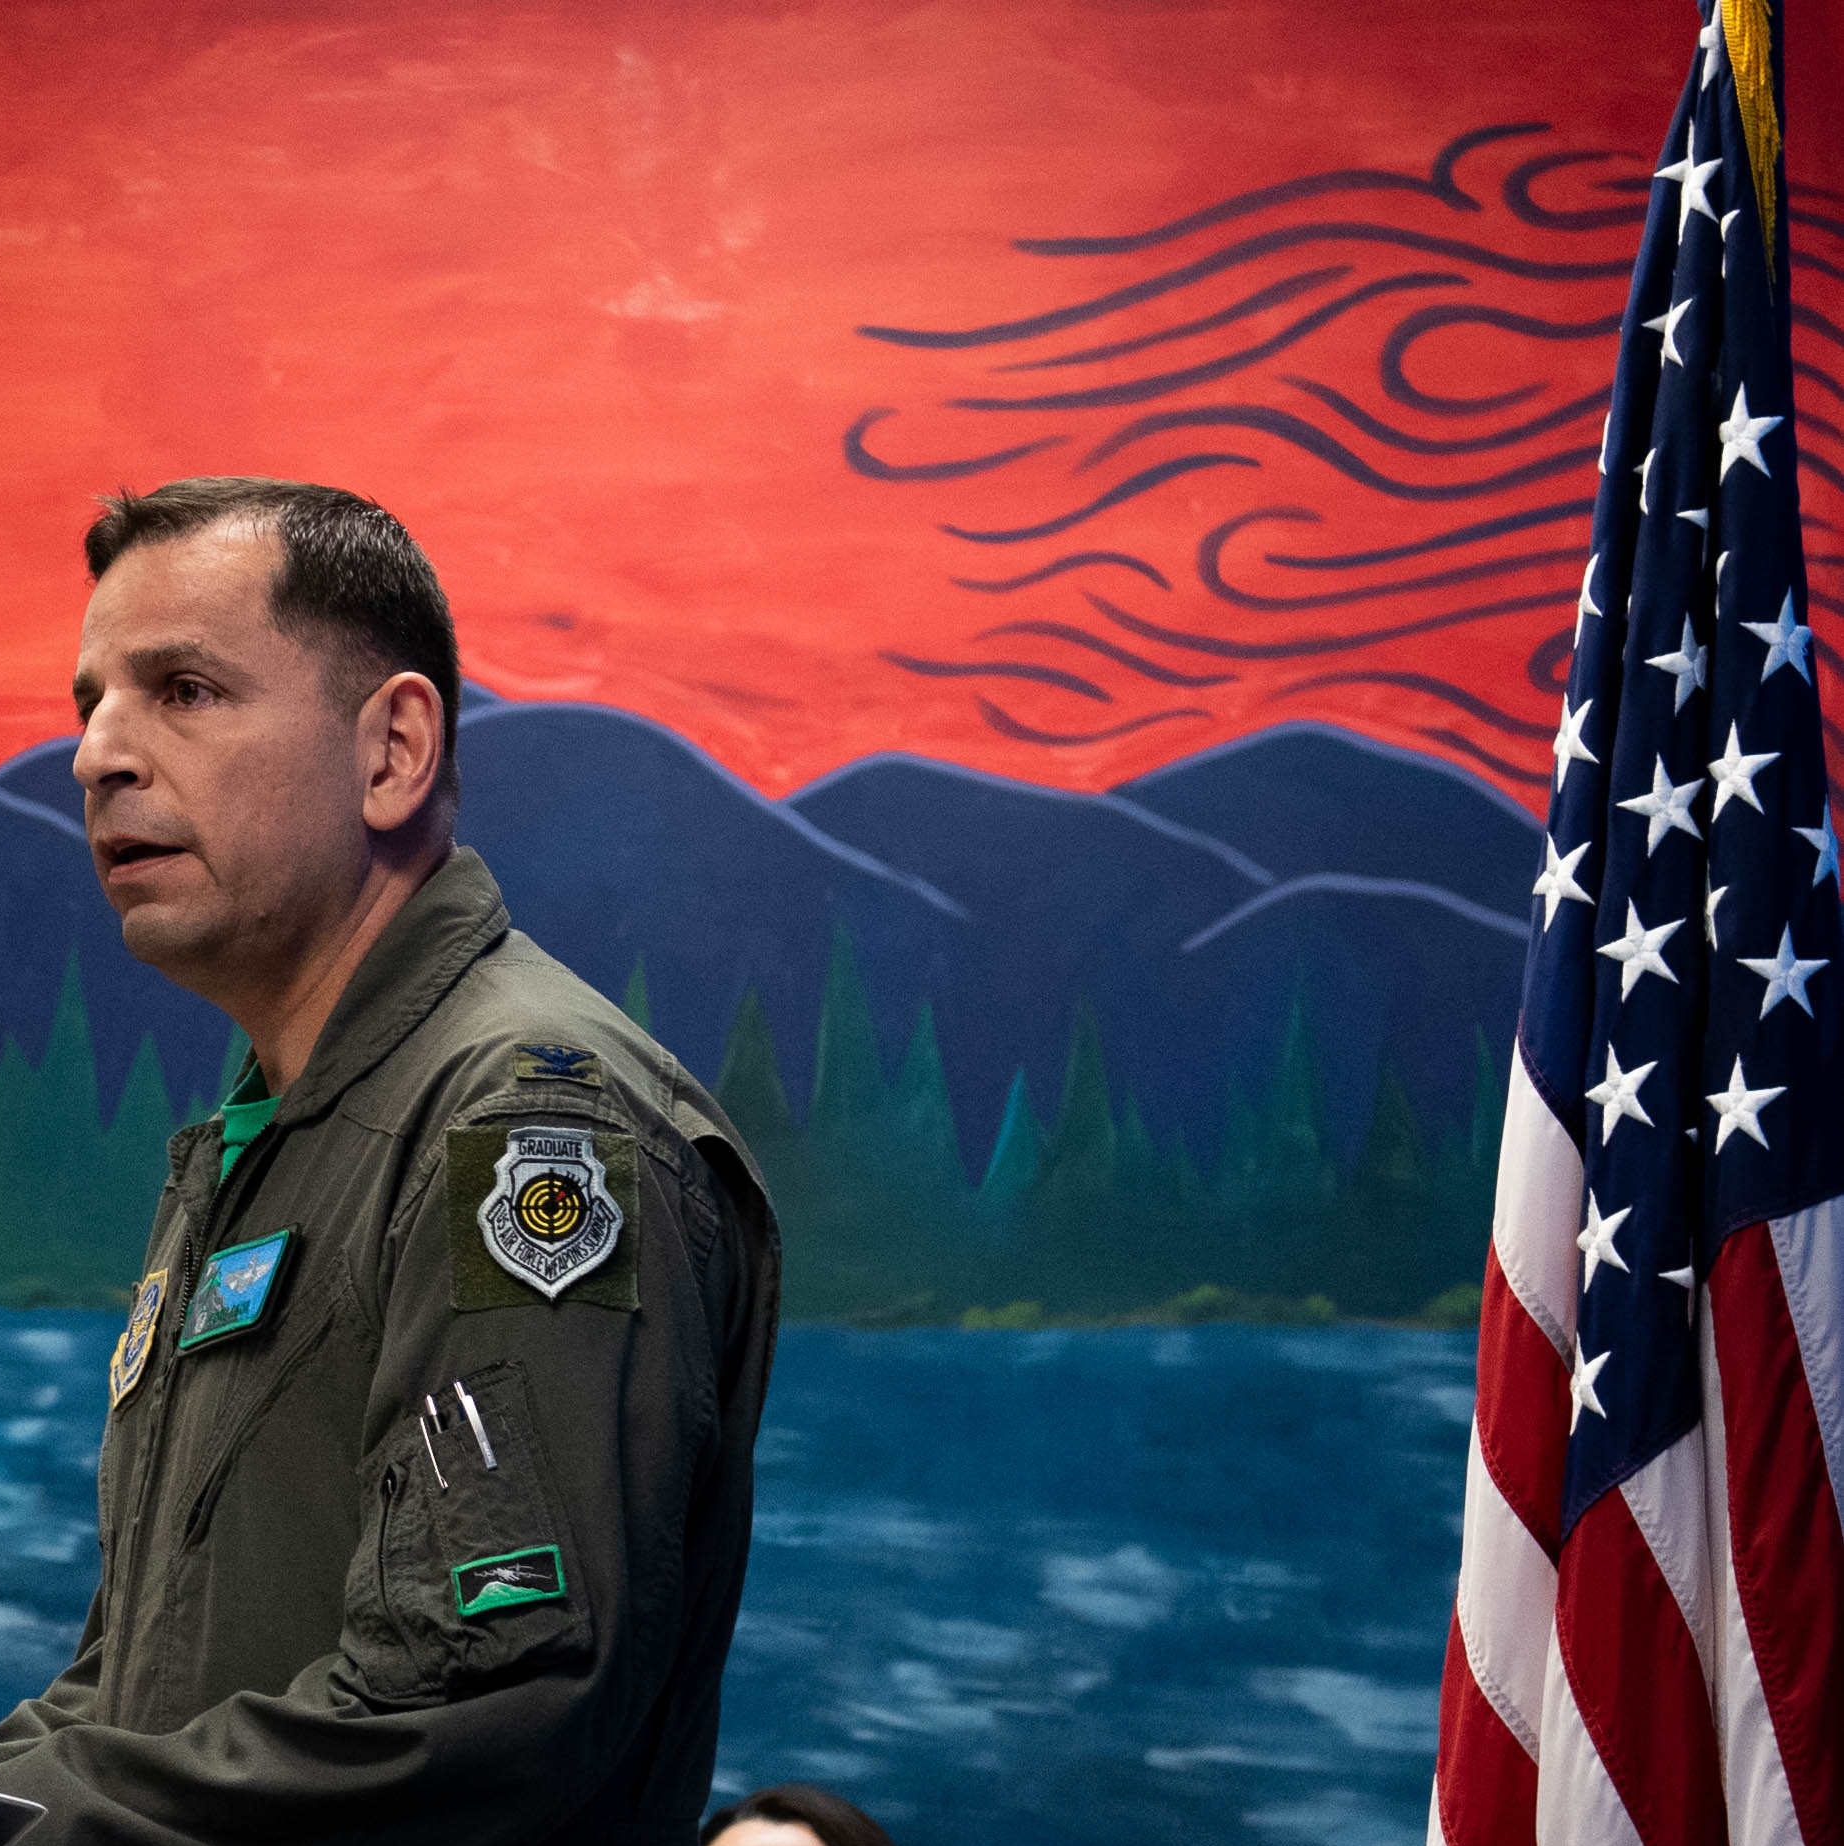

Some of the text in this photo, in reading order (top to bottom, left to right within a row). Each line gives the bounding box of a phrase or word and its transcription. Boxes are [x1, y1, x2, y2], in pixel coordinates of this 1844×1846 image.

[518, 1140, 583, 1158] GRADUATE
[496, 1207, 608, 1279] US AIR FORCE WEAPONS SCHOOL
